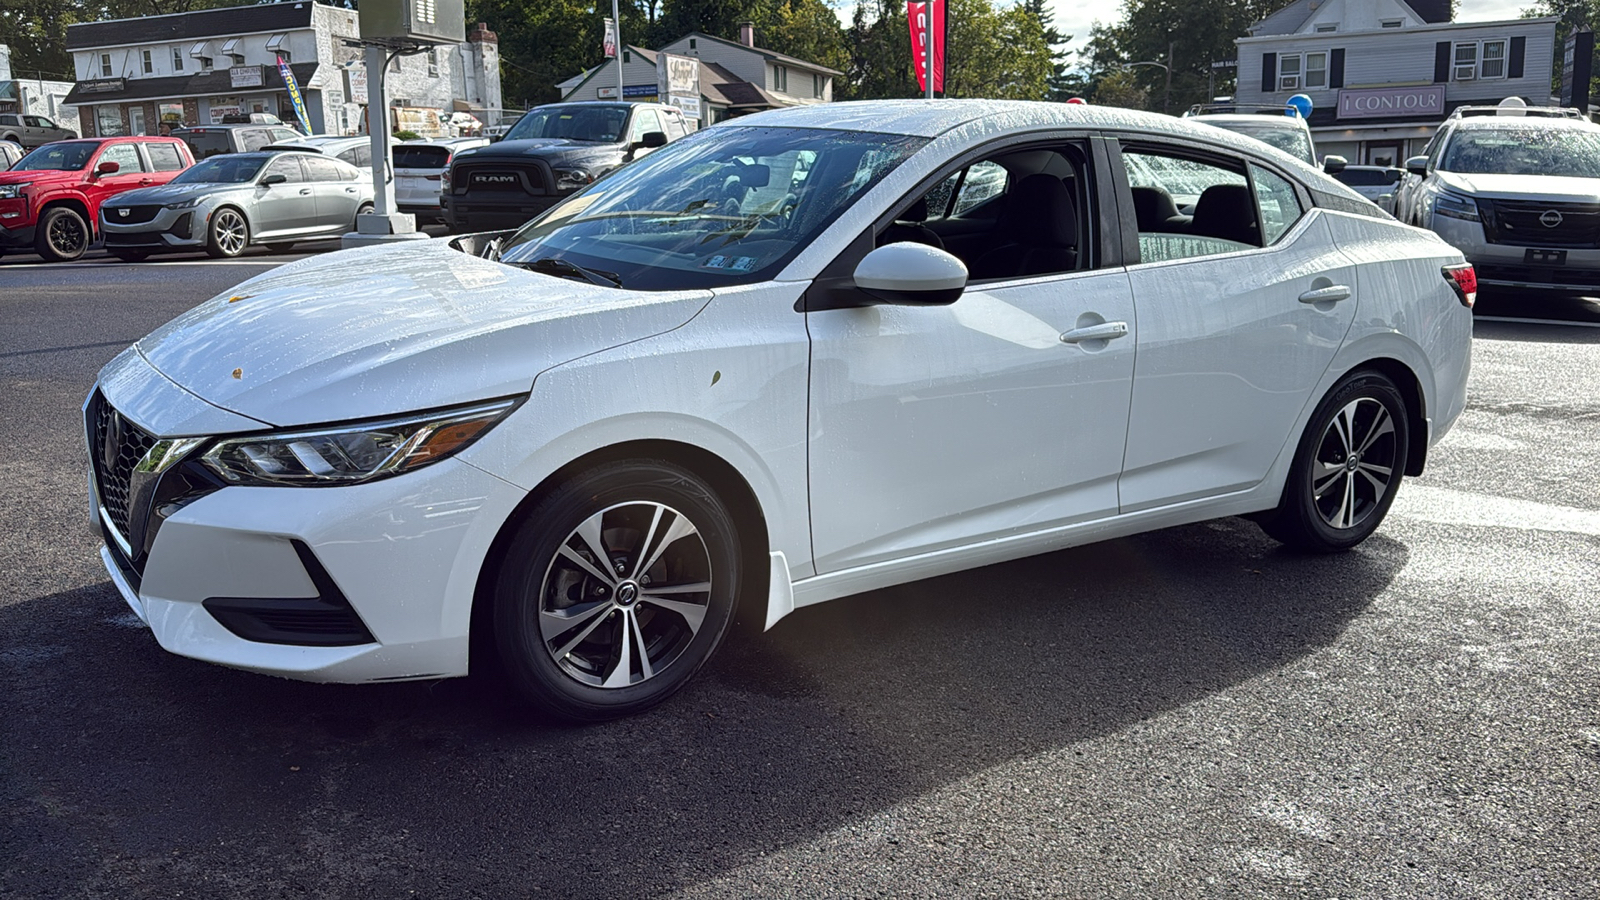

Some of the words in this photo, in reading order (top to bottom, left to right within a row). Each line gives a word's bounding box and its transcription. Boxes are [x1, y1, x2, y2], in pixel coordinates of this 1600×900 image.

[1345, 95, 1350, 111] i
[1355, 94, 1436, 110] CONTOUR
[211, 107, 240, 117] COMPUTERS
